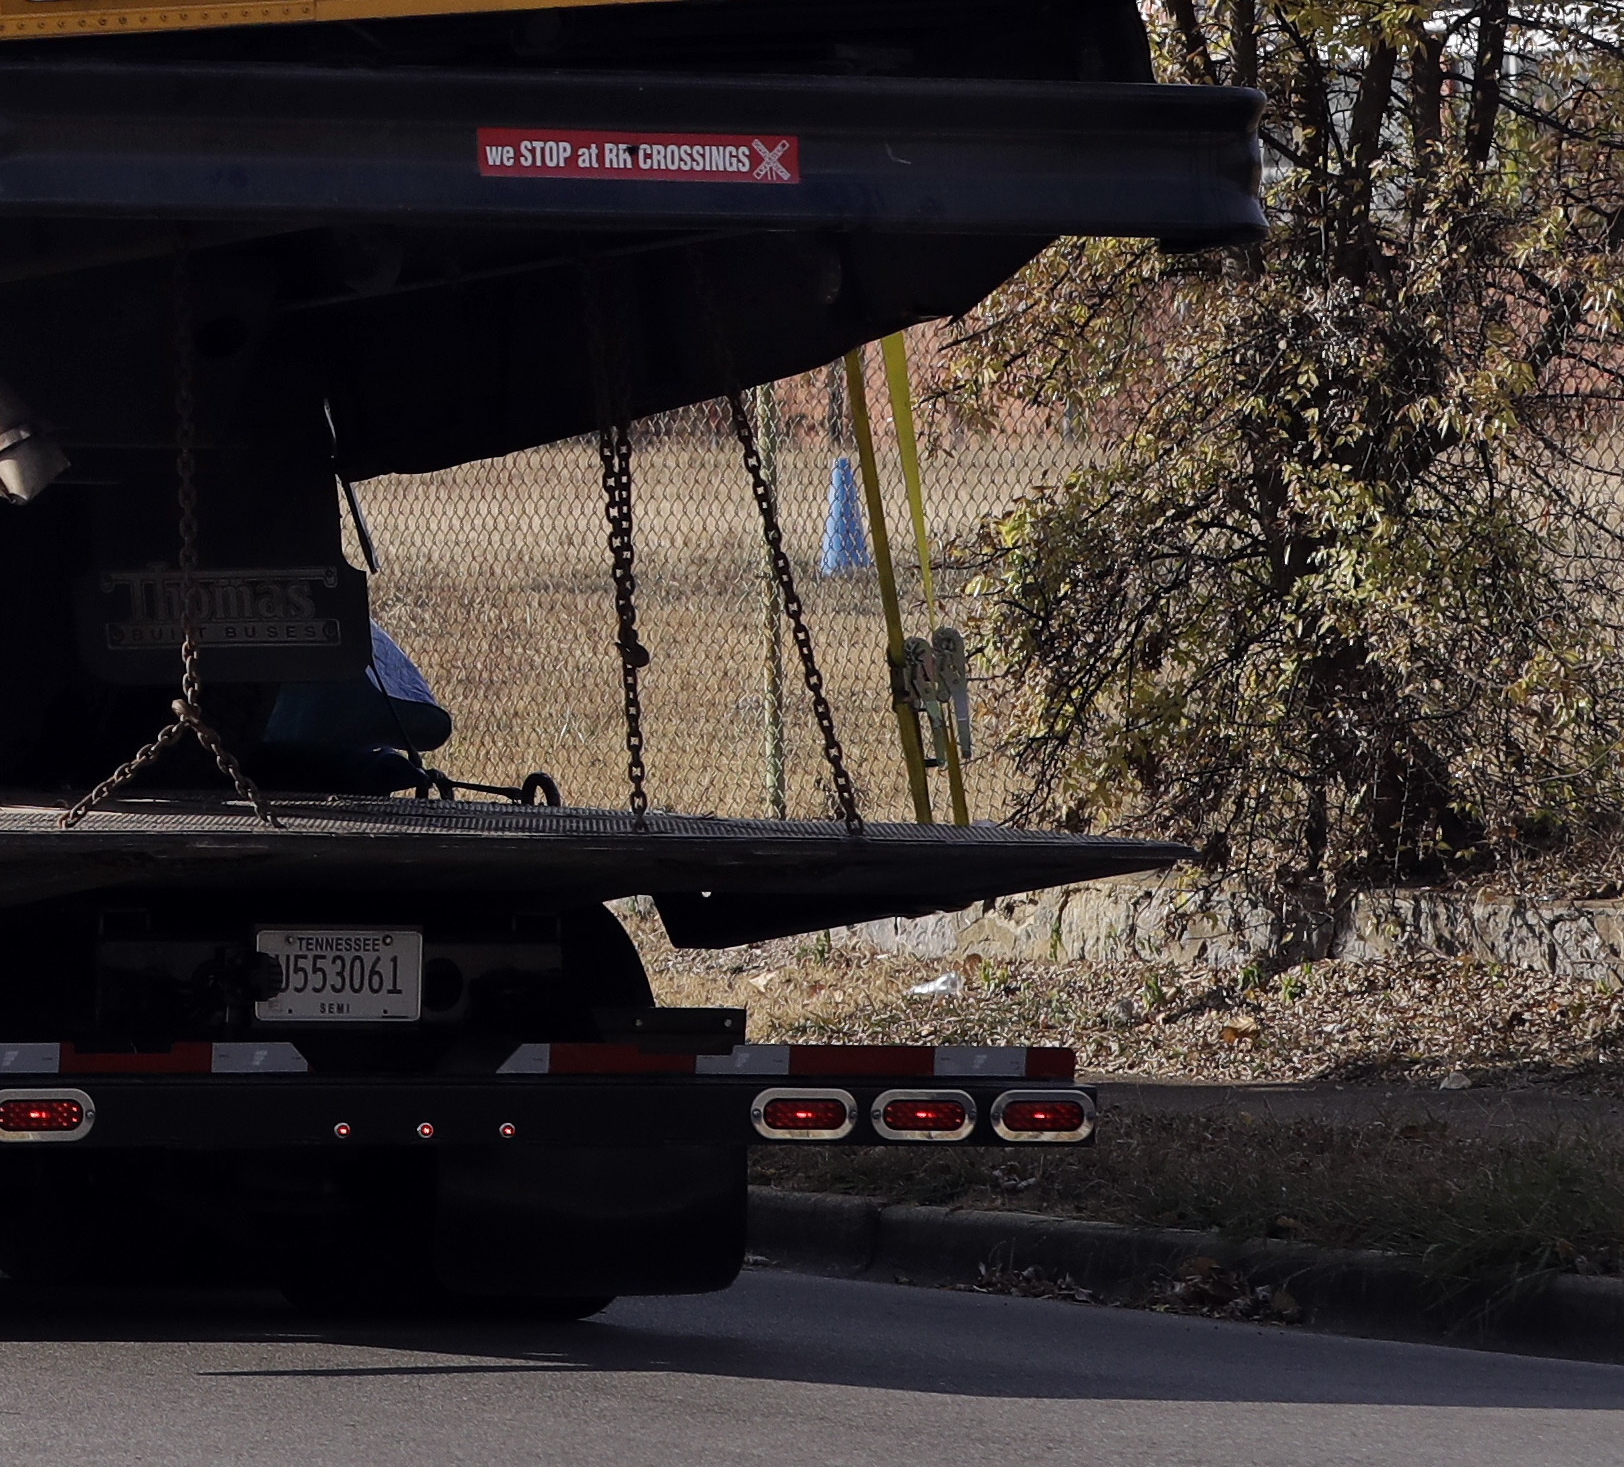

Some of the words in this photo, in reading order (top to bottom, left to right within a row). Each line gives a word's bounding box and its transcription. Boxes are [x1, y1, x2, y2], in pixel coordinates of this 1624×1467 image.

[485, 145, 514, 166] we
[519, 140, 571, 167] STOP
[577, 145, 599, 168] at
[638, 144, 750, 172] CROSSINGS
[225, 626, 317, 639] BUSES
[297, 937, 380, 952] TENNESSEE
[319, 1003, 350, 1015] SEMI
